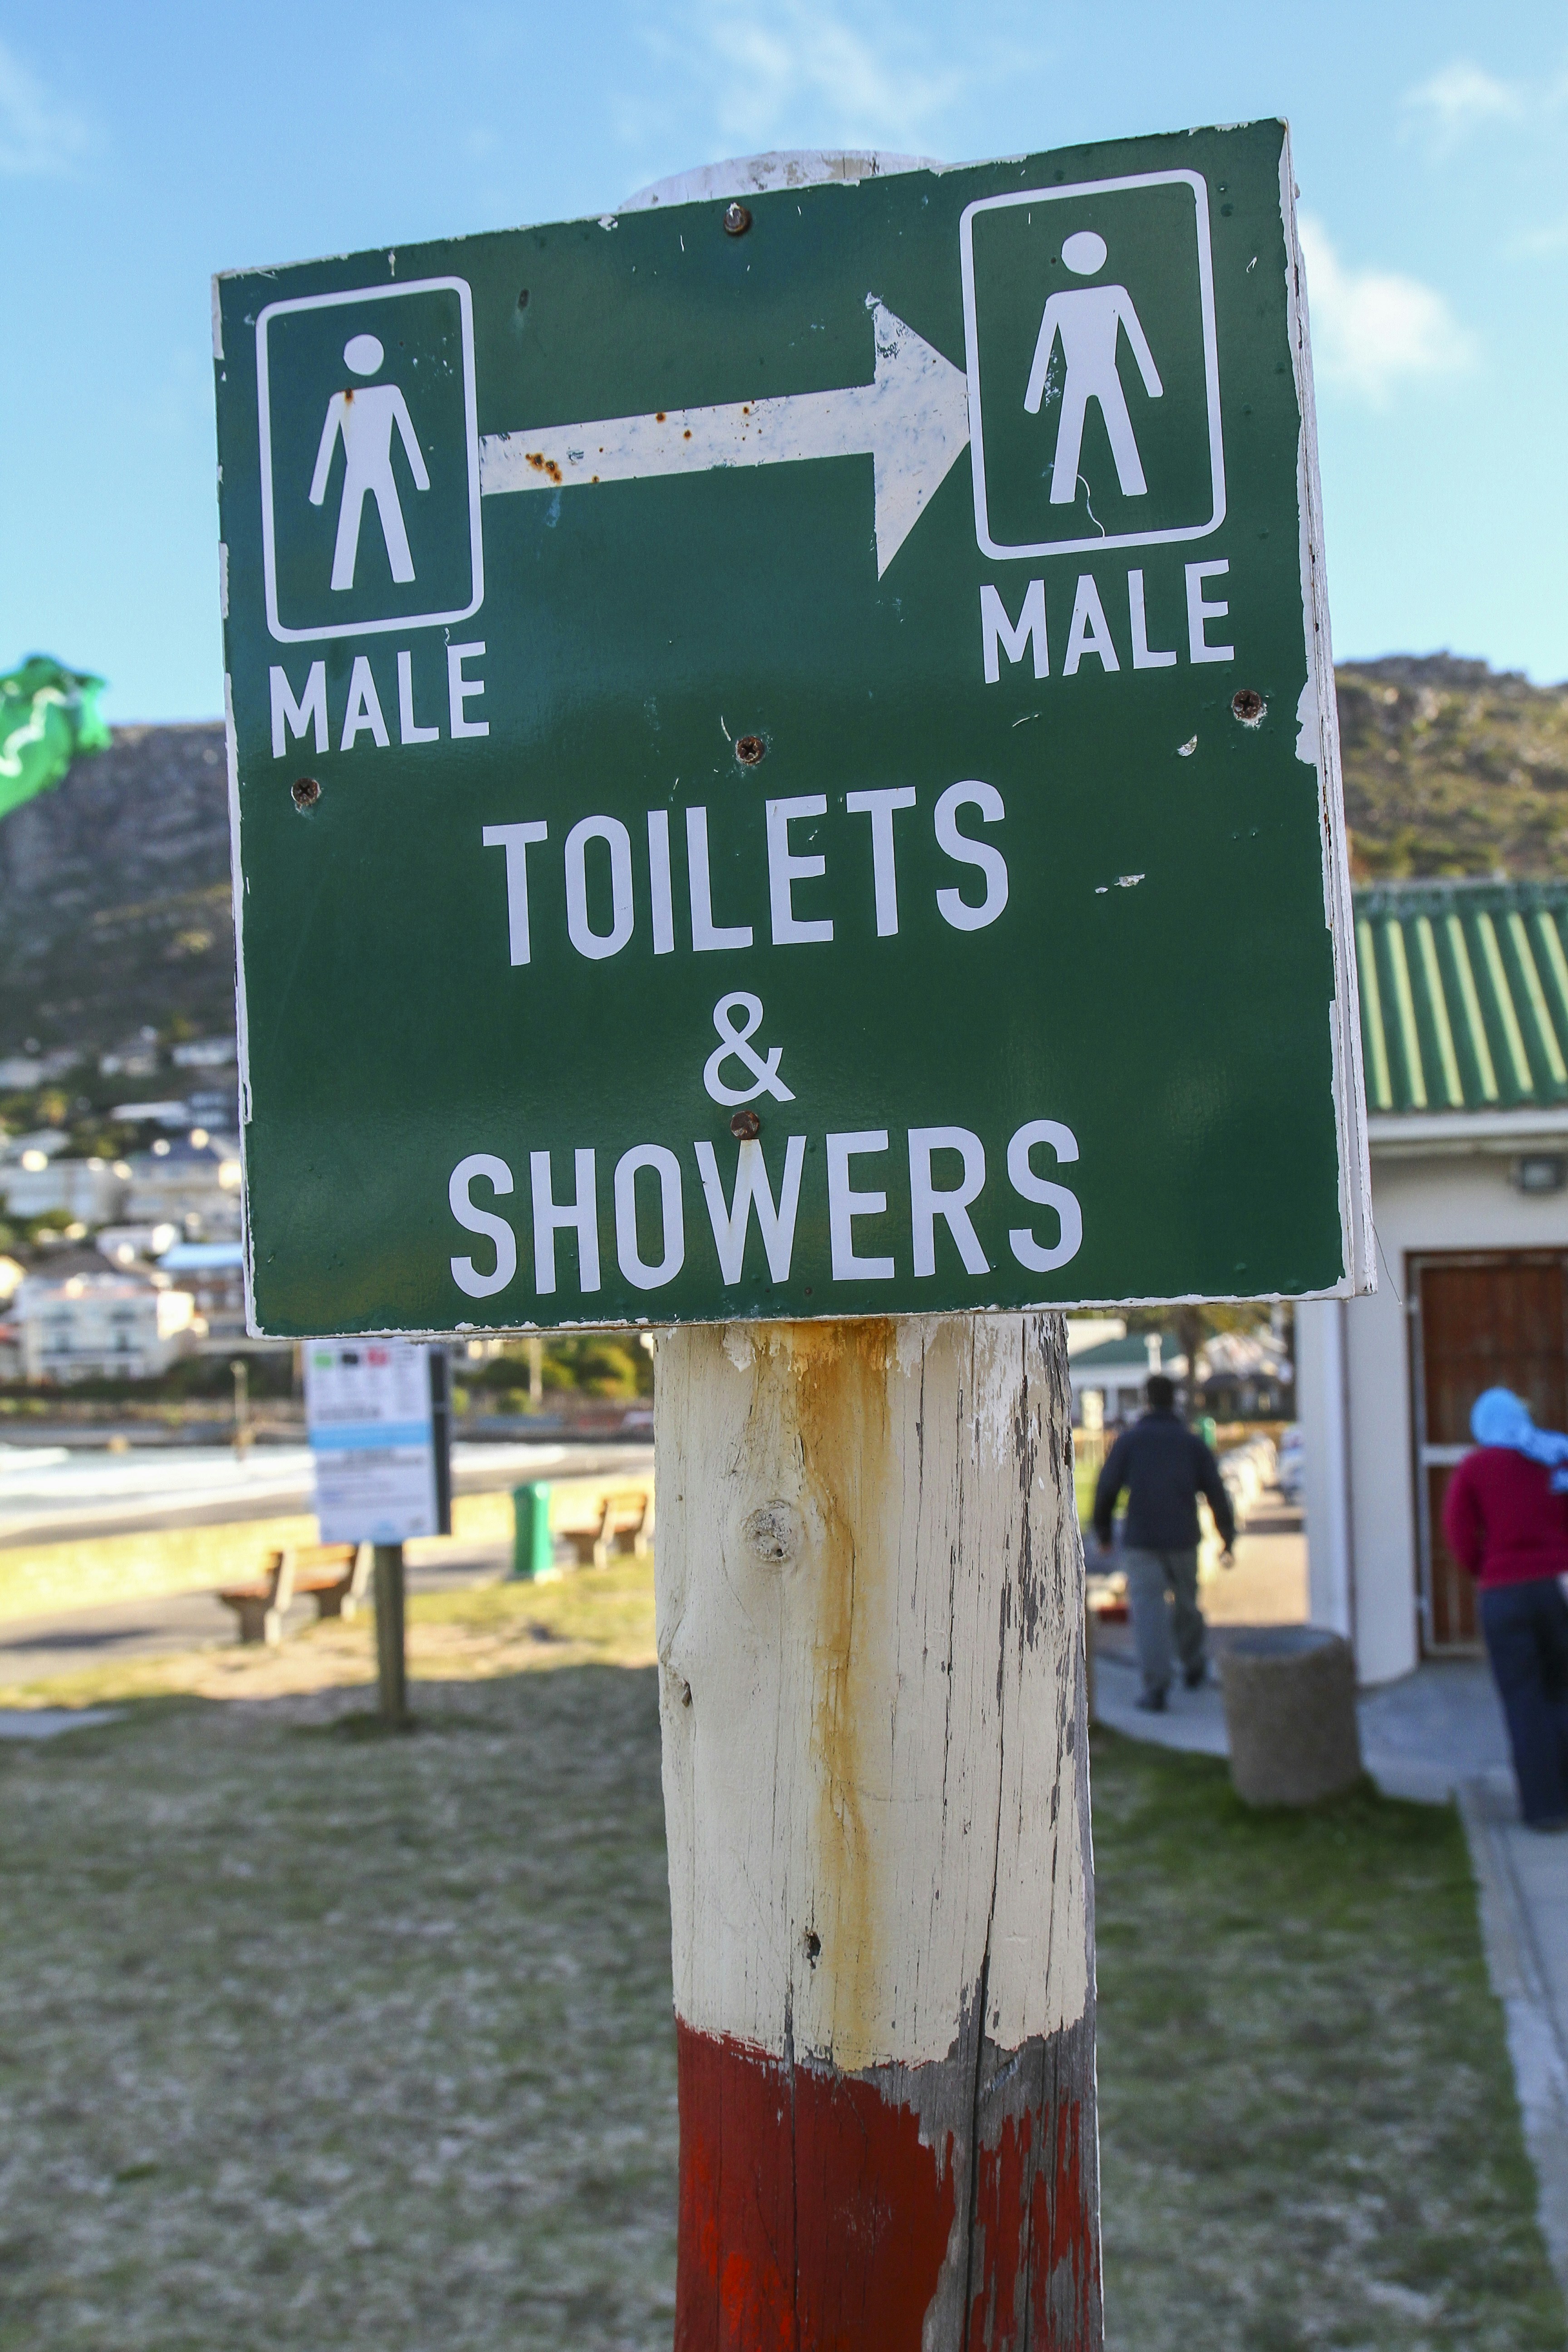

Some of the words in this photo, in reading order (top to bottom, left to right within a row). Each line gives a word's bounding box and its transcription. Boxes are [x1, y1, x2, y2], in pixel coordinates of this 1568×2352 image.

[980, 559, 1235, 683] MALE
[270, 642, 490, 758] MALE
[483, 780, 1008, 966] TOILETS
[704, 992, 796, 1106] &
[449, 1120, 1082, 1298] SHOWERS
